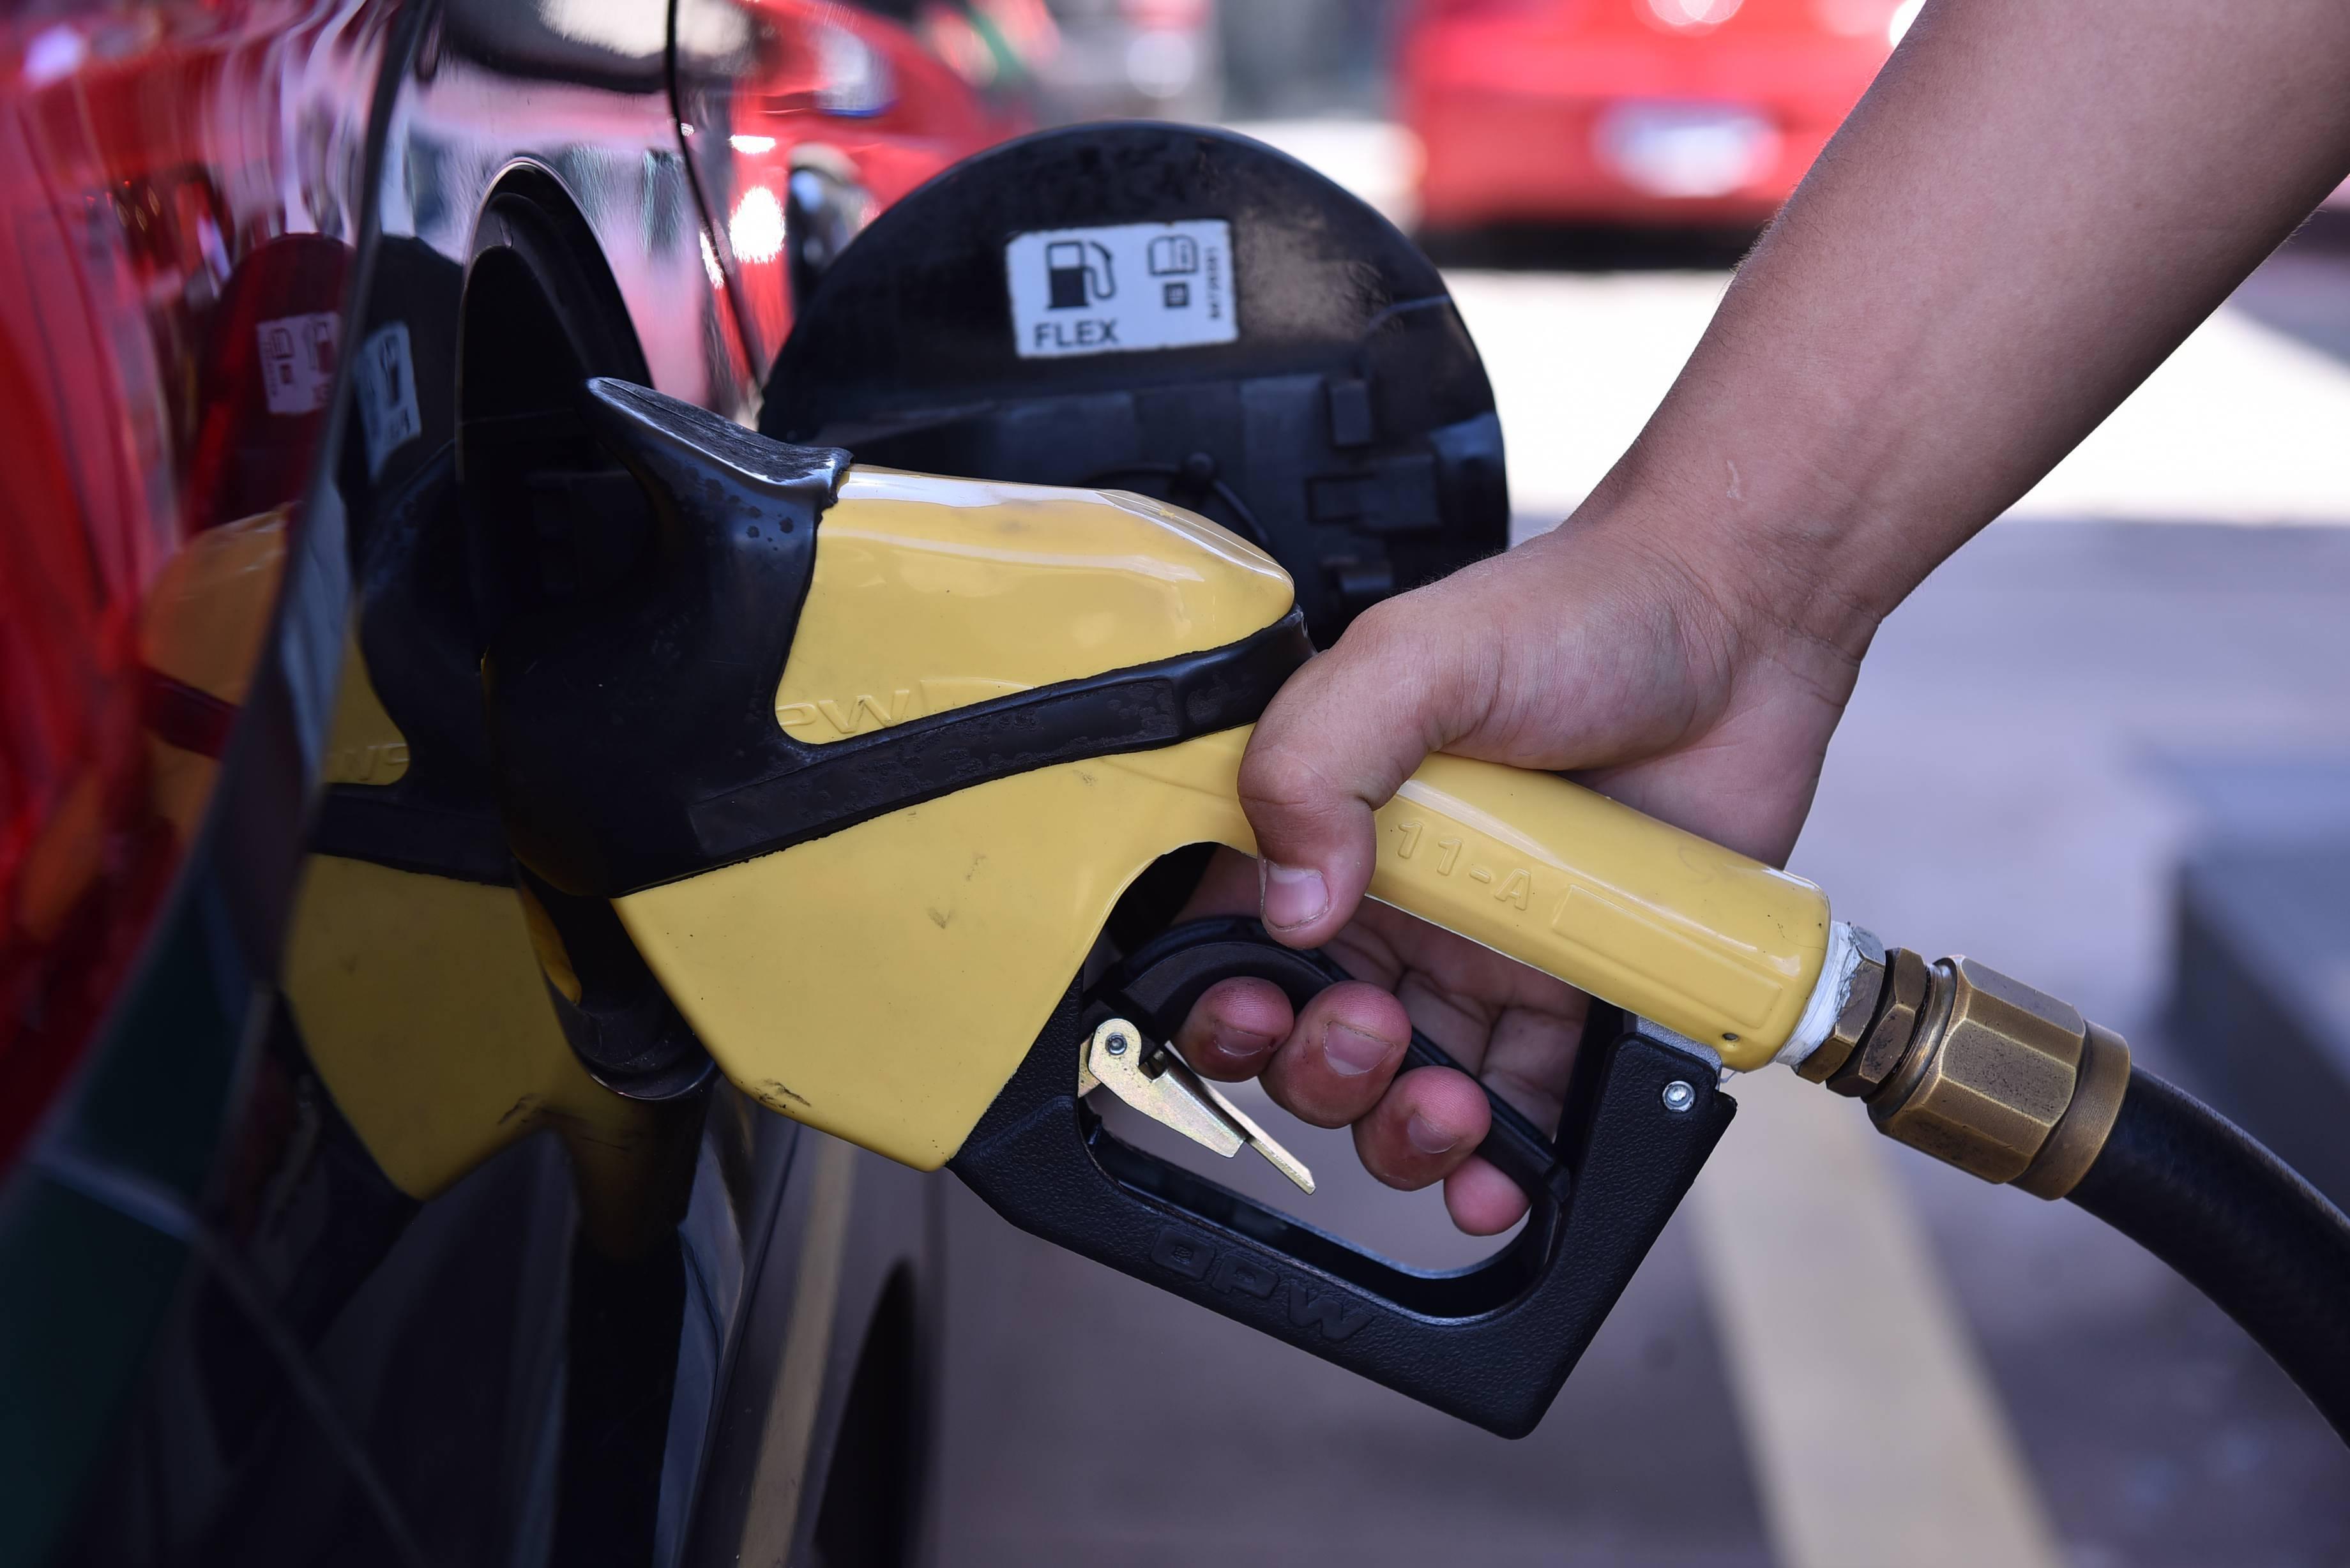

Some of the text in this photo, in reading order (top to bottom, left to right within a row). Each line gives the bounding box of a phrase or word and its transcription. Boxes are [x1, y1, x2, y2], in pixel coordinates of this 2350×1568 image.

[1033, 318, 1119, 349] FLEX
[1397, 820, 1532, 912] 11-A
[1150, 1225, 1374, 1341] OPW
